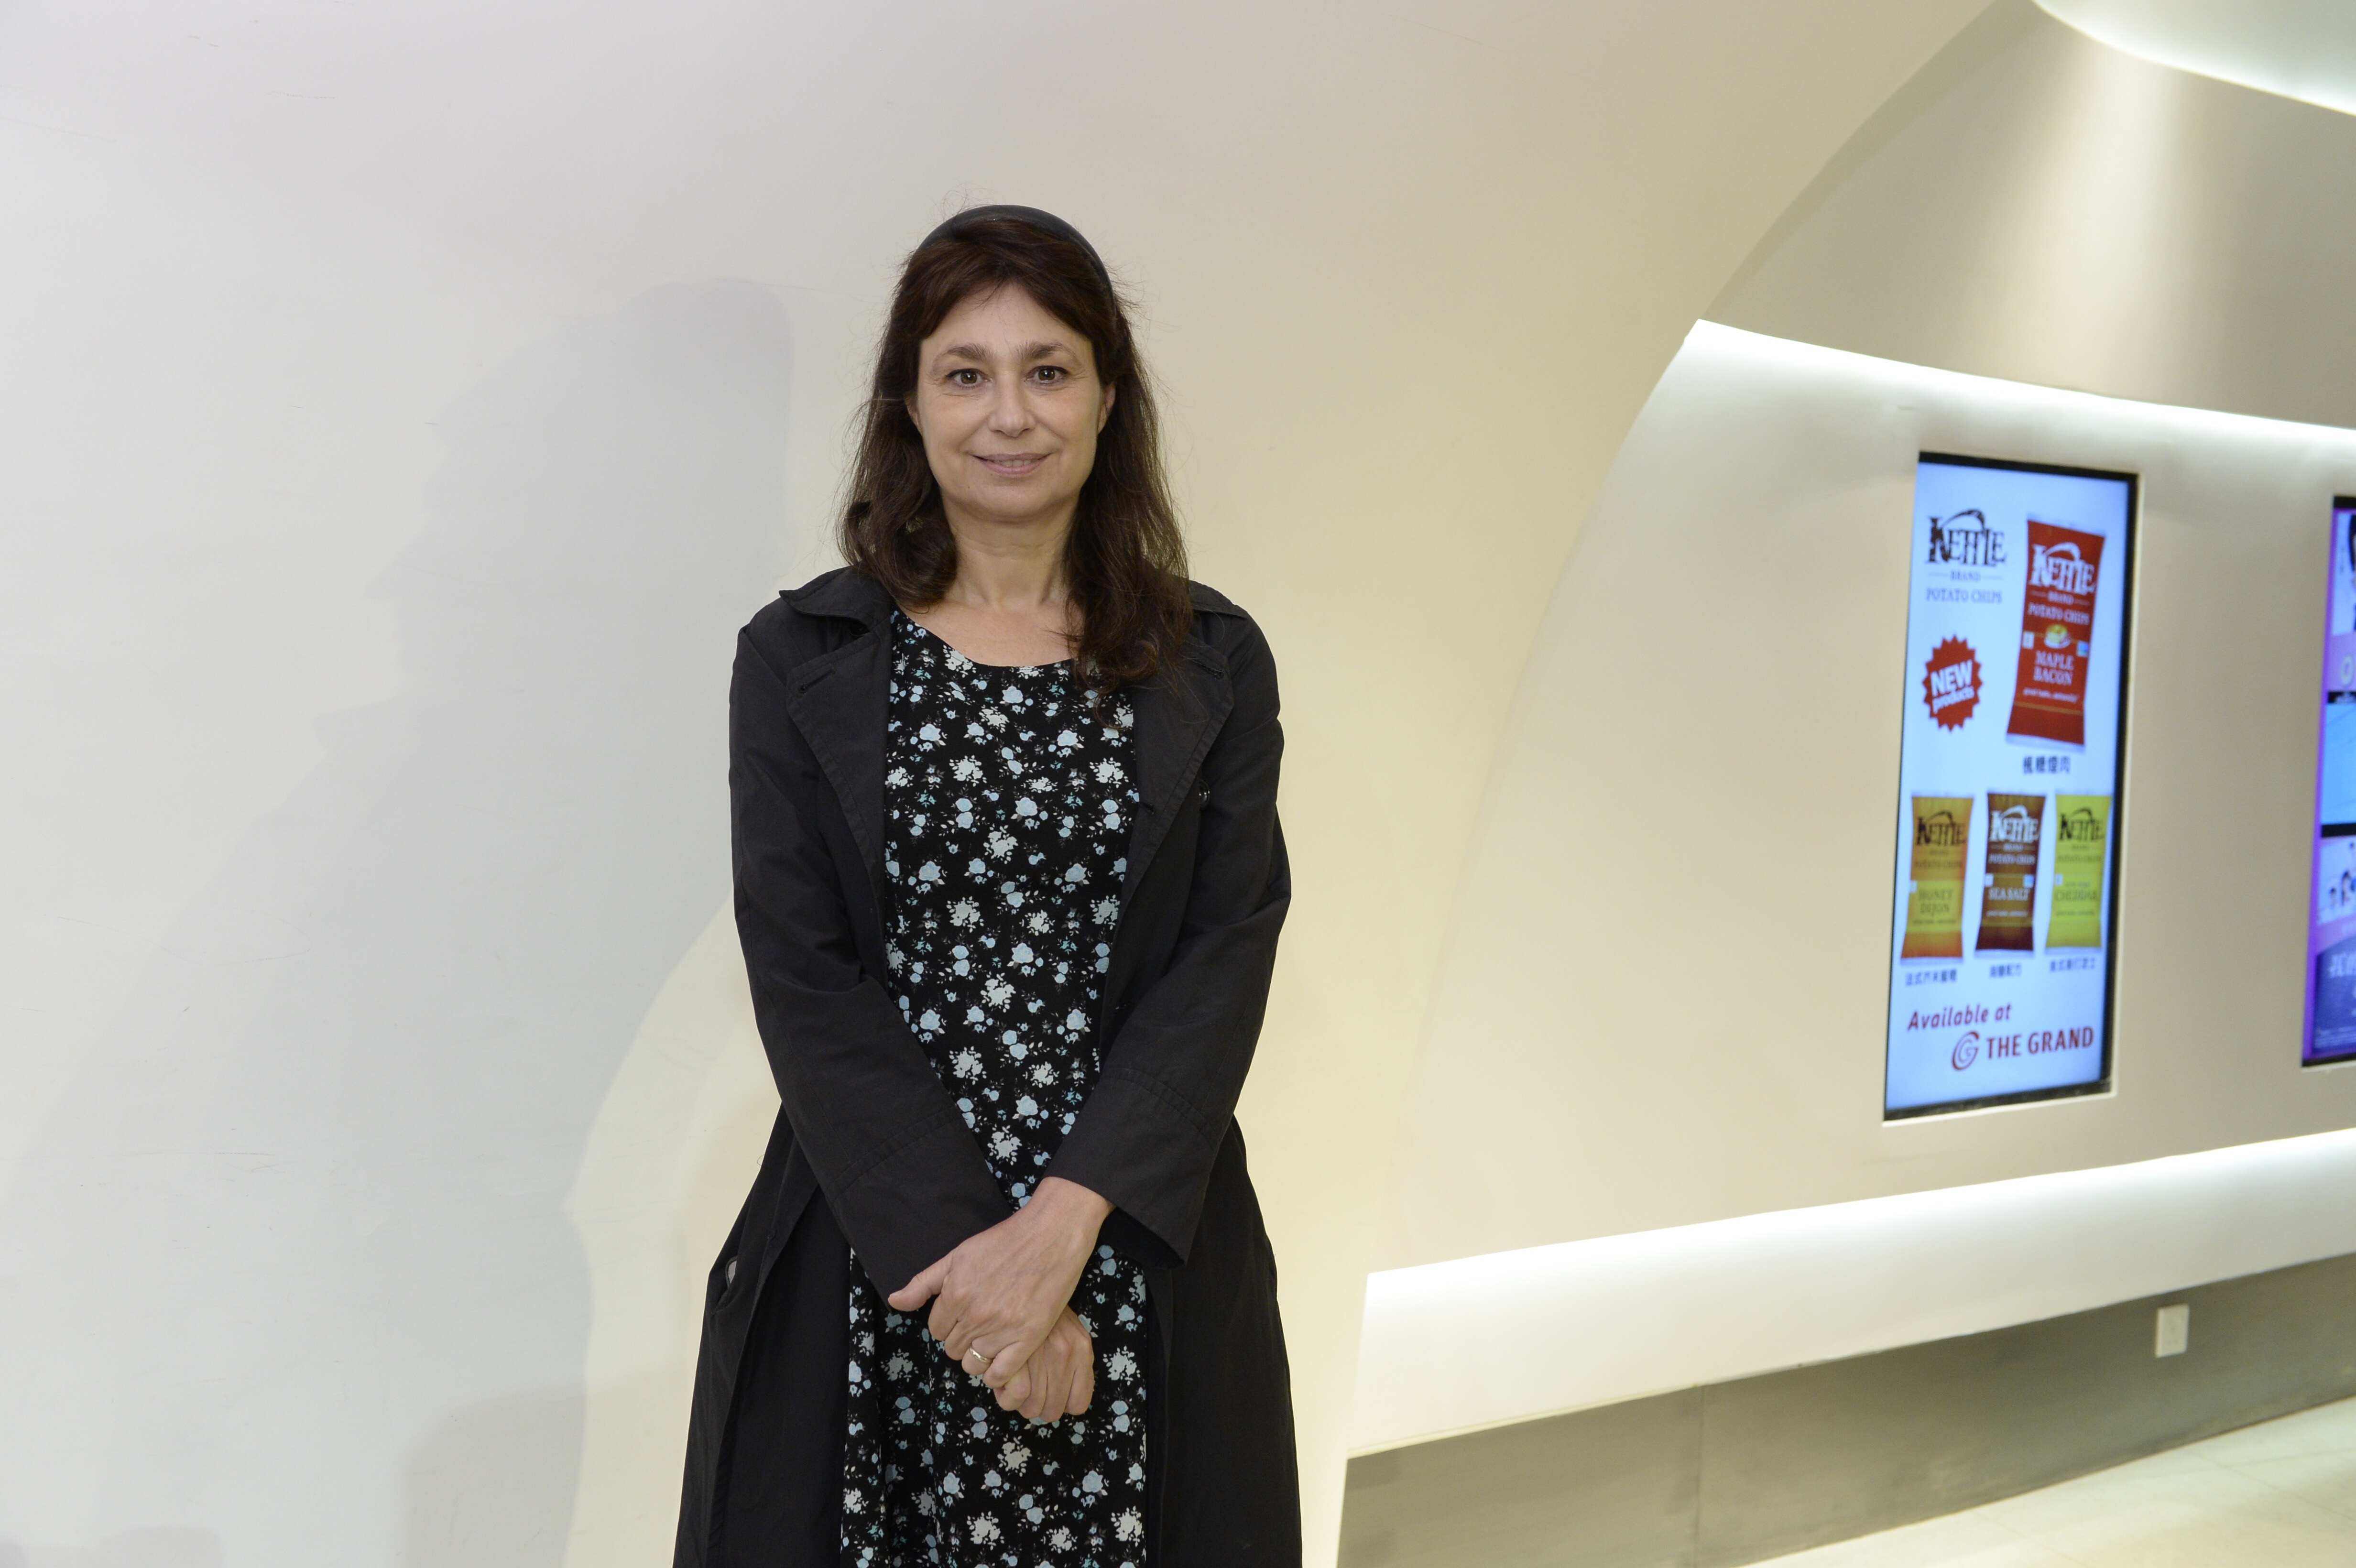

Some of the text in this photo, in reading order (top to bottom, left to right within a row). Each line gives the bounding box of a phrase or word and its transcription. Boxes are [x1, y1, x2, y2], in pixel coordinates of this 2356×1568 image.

[1926, 588, 2002, 604] POTATO CHIPS
[2028, 603, 2090, 625] POTATO CHIPS
[2035, 650, 2073, 670] MAPLE
[1931, 659, 1973, 697] NEW
[2033, 666, 2073, 685] BACON
[1988, 888, 2030, 901] SEA SALT
[1908, 1002, 2011, 1031] Available at
[1986, 1035, 2021, 1059] THE
[2028, 1026, 2094, 1055] GRAND
